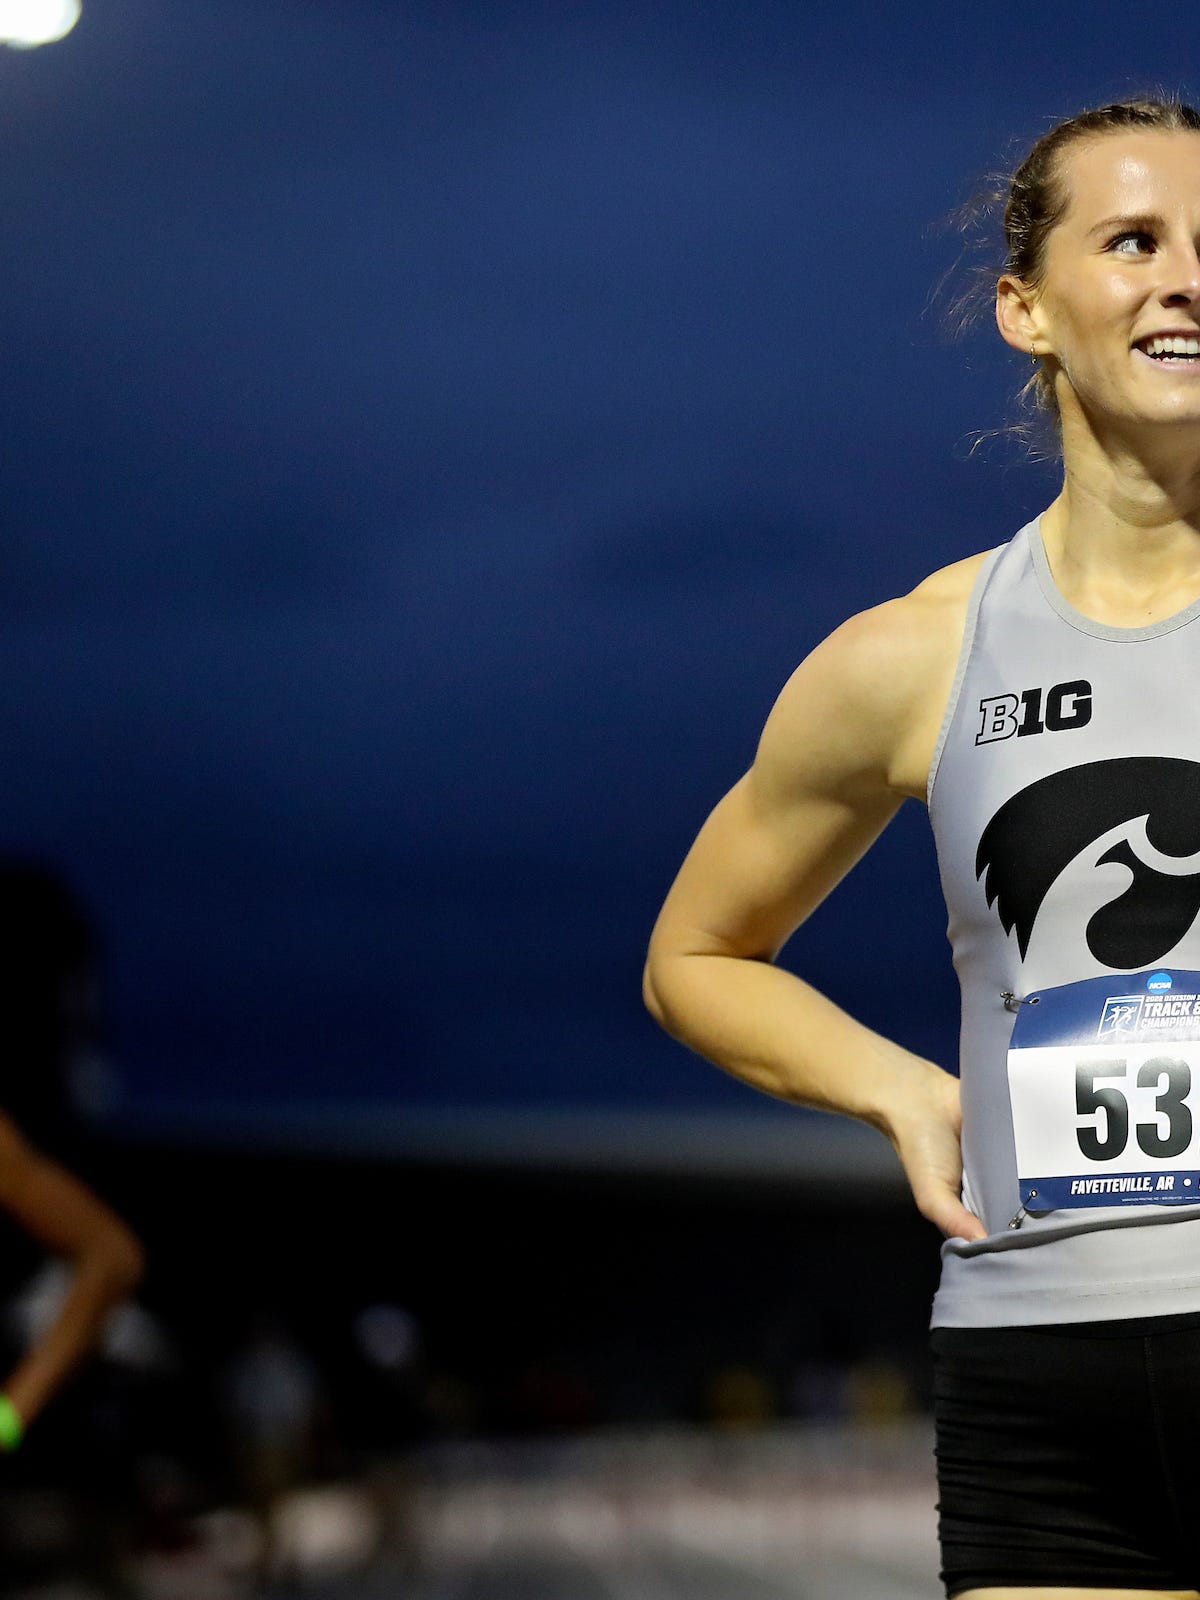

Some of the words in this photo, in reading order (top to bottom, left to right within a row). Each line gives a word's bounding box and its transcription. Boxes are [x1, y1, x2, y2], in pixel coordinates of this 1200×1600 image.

[1144, 1001, 1192, 1017] TRACK
[1071, 1177, 1153, 1195] FAYETTEVILLE,
[1156, 1176, 1175, 1191] AR
